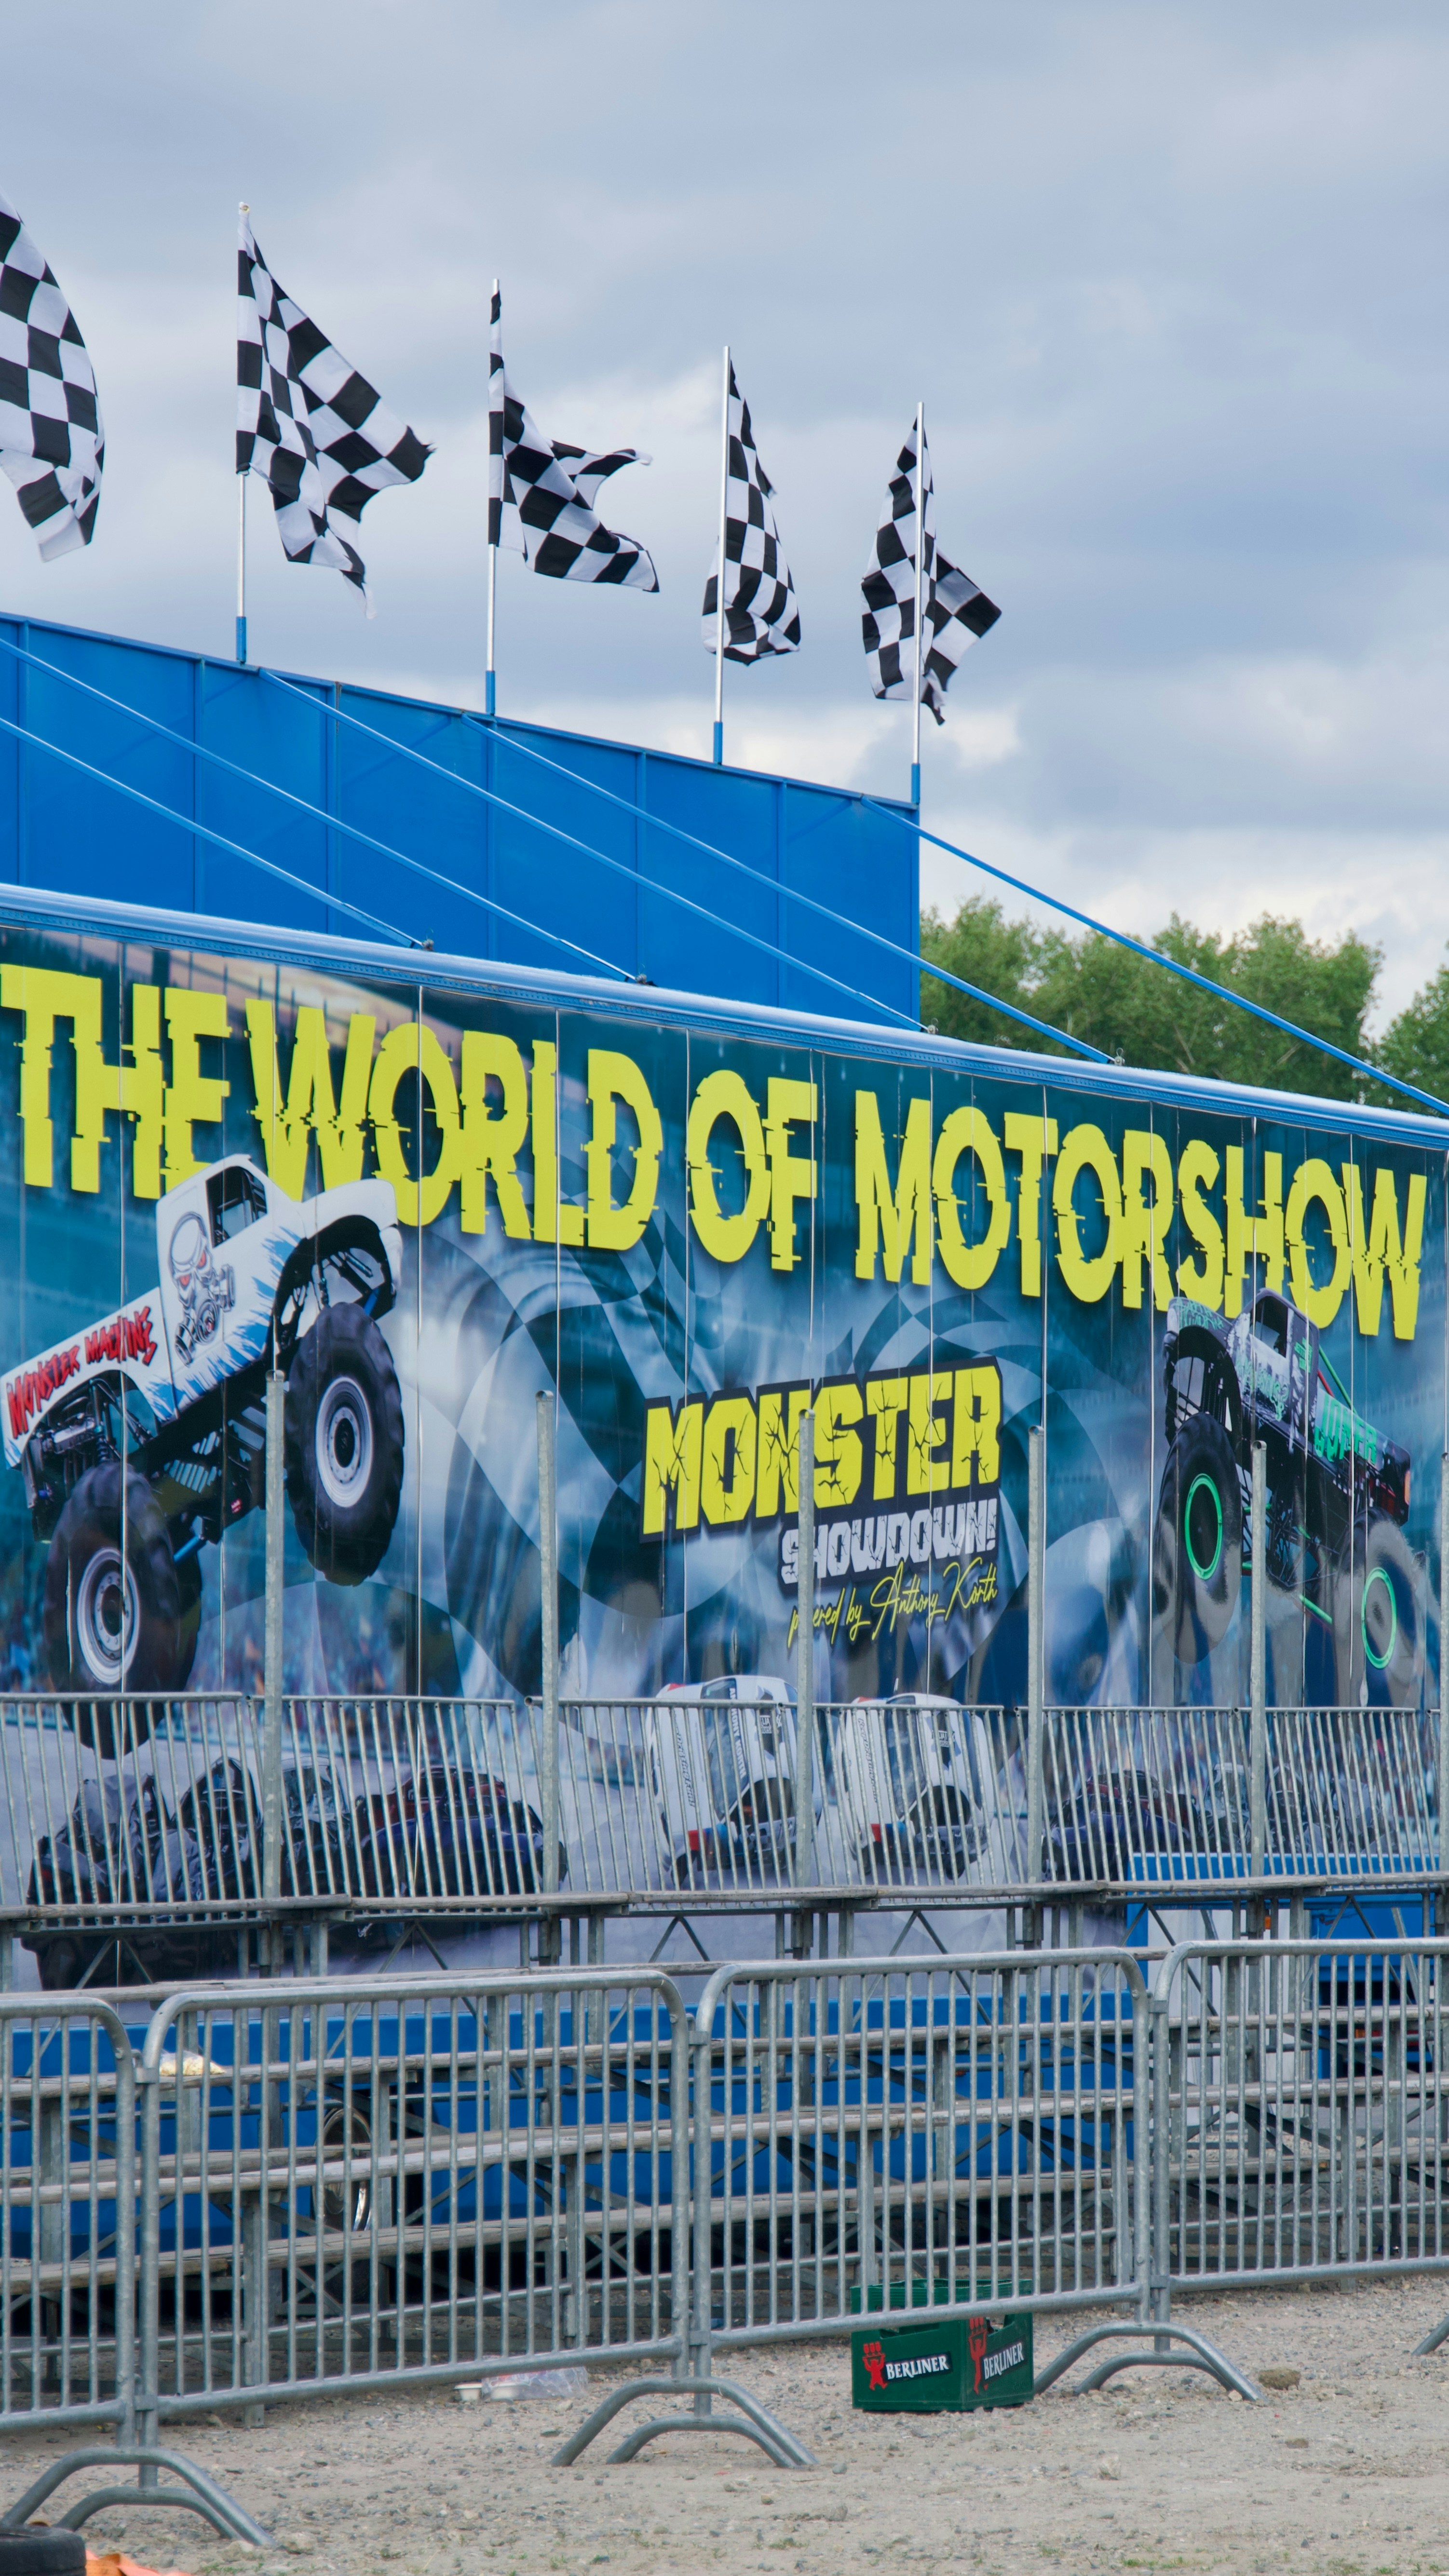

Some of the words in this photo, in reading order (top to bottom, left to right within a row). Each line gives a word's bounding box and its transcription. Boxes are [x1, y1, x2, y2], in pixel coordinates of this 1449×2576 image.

[0, 963, 232, 1199] THE
[244, 998, 663, 1251] WORLD
[686, 1070, 818, 1271] OF
[854, 1090, 1428, 1340] MOTORSHOW
[6, 1345, 80, 1440] MONSTER
[84, 1306, 157, 1366] MACHINE
[643, 1365, 1000, 1535] MONSTER
[781, 1498, 997, 1584] SHOWDOWN!
[787, 1587, 845, 1648] pered
[846, 1588, 871, 1641] by
[870, 1561, 946, 1641] Anthony
[943, 1556, 997, 1621] Korth
[729, 1687, 741, 1737] ANHONY
[885, 2355, 949, 2380] BERLINER
[983, 2342, 1025, 2380] BERLINER
